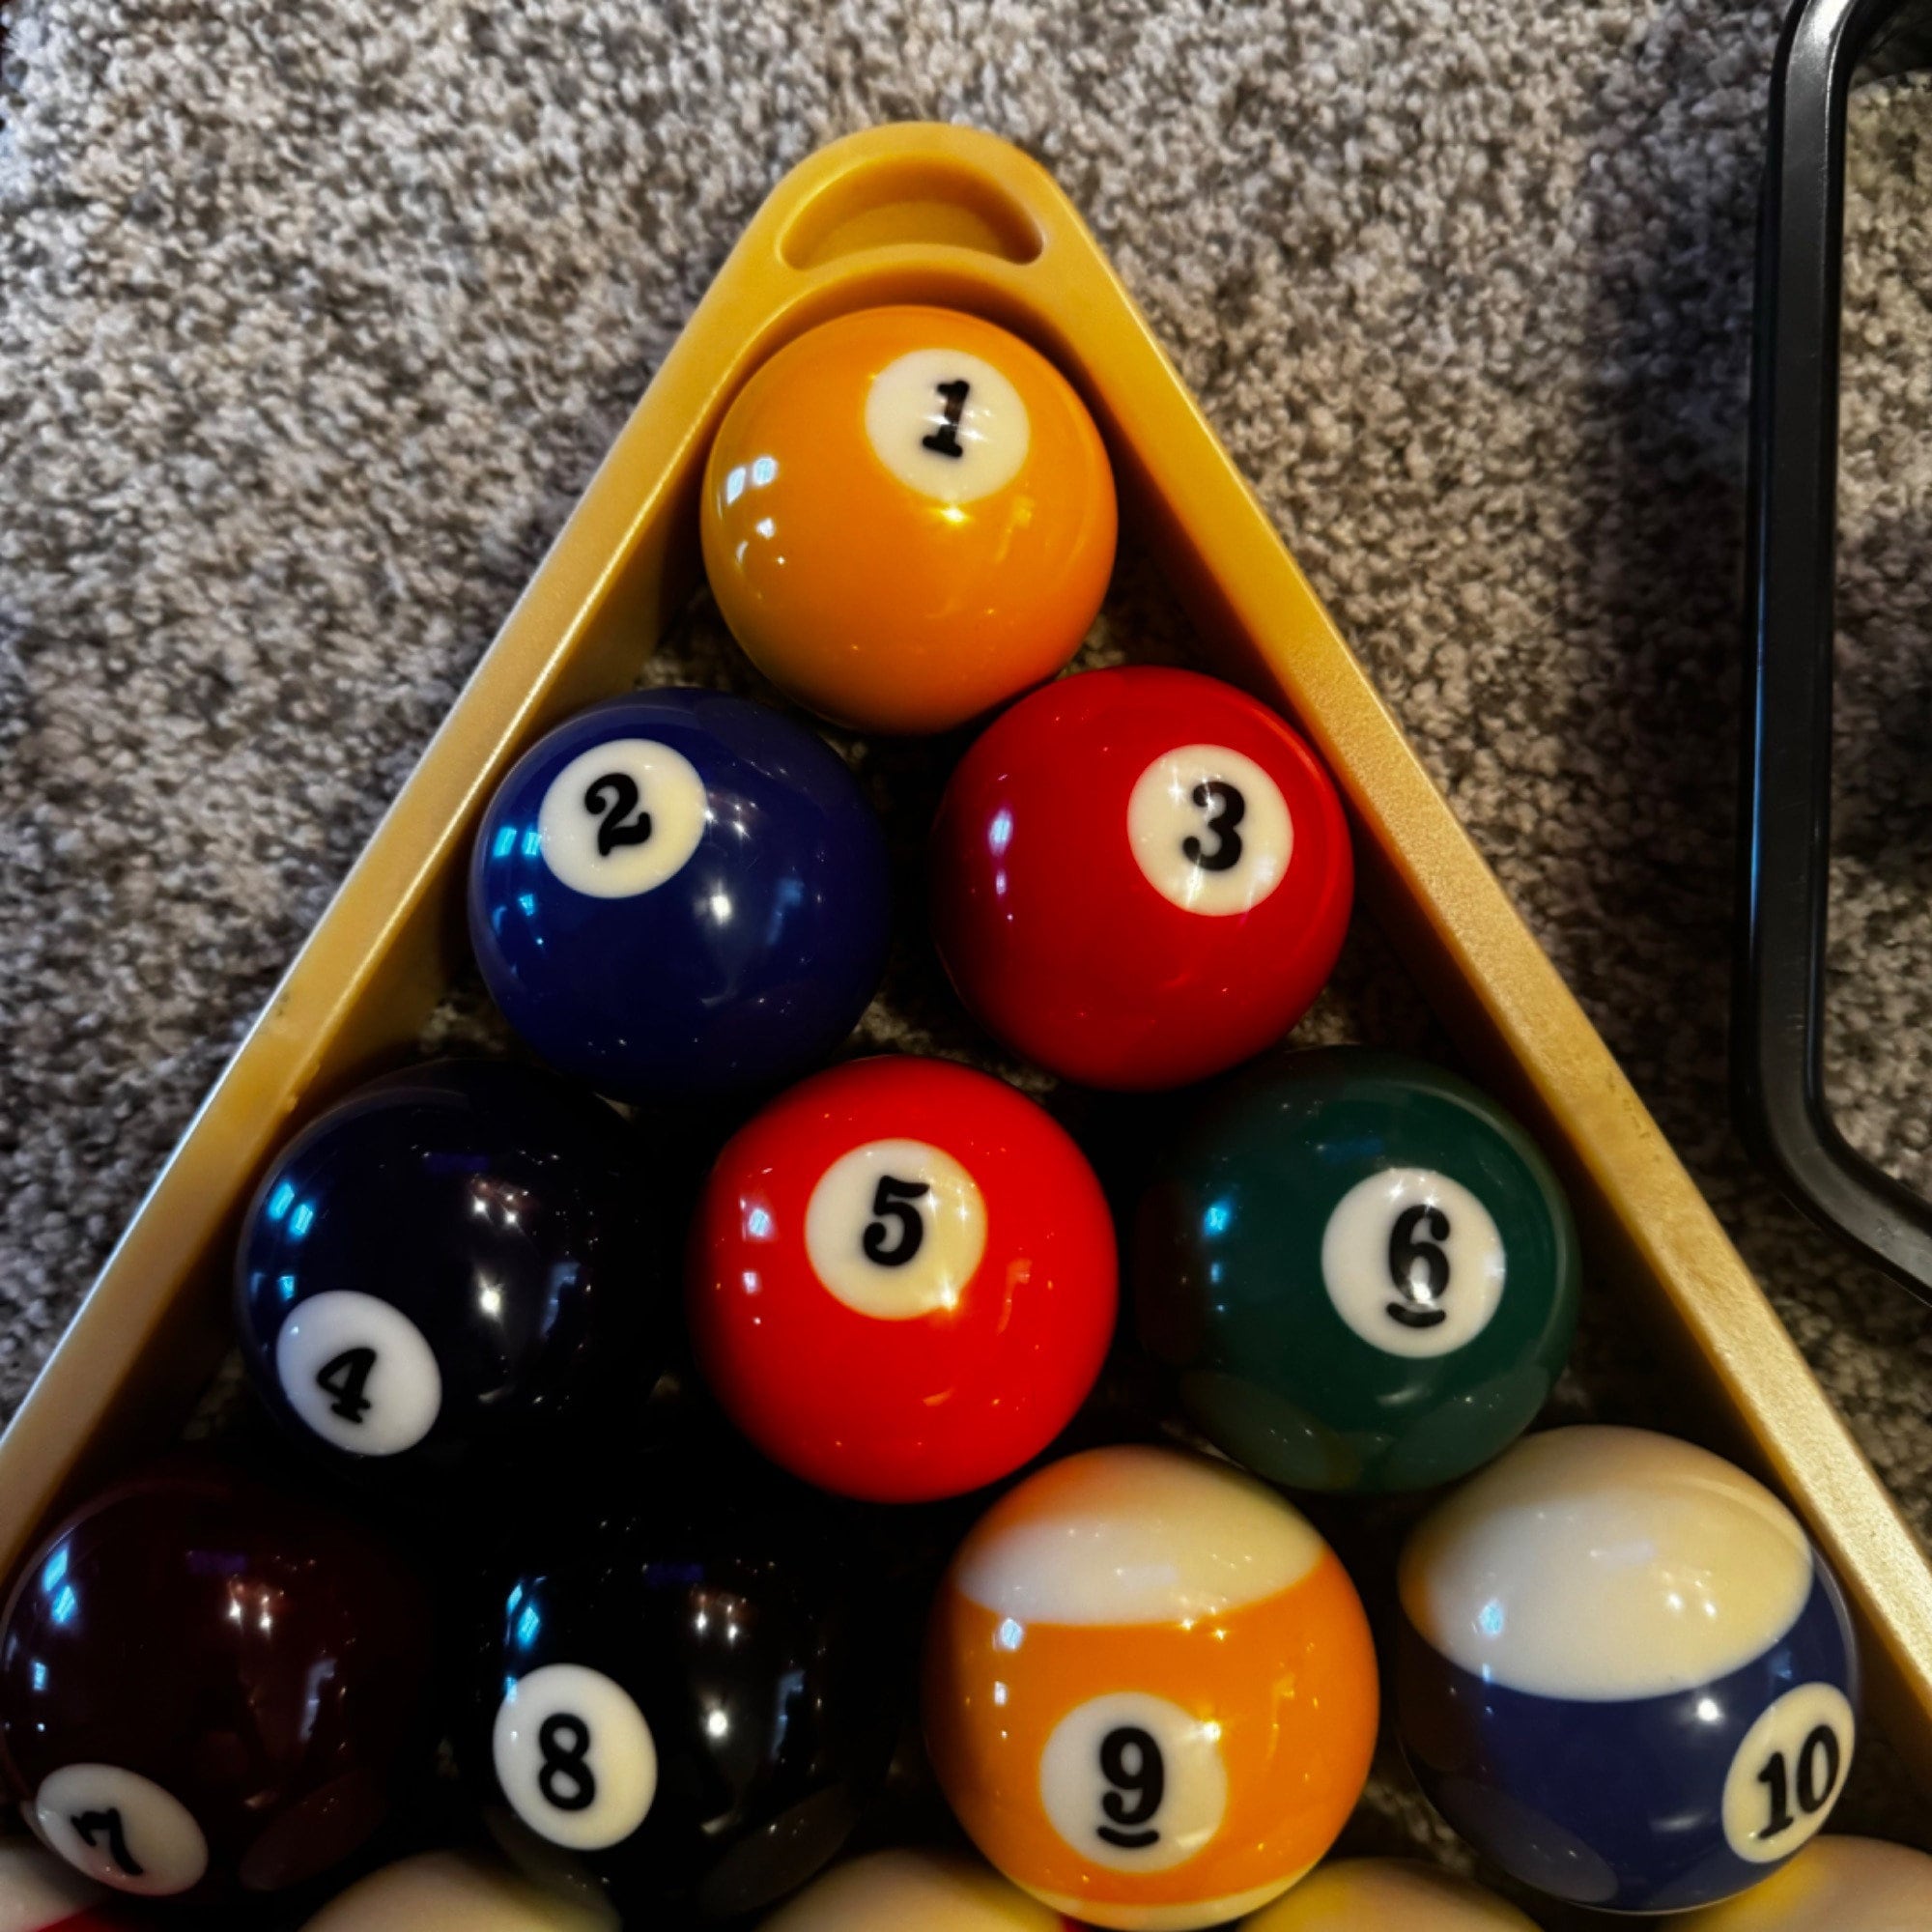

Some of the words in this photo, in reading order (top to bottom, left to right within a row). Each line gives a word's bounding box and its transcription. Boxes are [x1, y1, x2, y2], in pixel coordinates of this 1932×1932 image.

[919, 378, 971, 459] 1
[582, 772, 652, 857] 2
[1180, 779, 1247, 873] 3
[861, 1174, 931, 1268] 5
[1384, 1203, 1452, 1329] 6
[315, 1346, 378, 1425] 4
[536, 1712, 597, 1813] 8
[1096, 1725, 1166, 1849] 9
[1756, 1722, 1841, 1841] 10
[70, 1806, 145, 1877] 7
